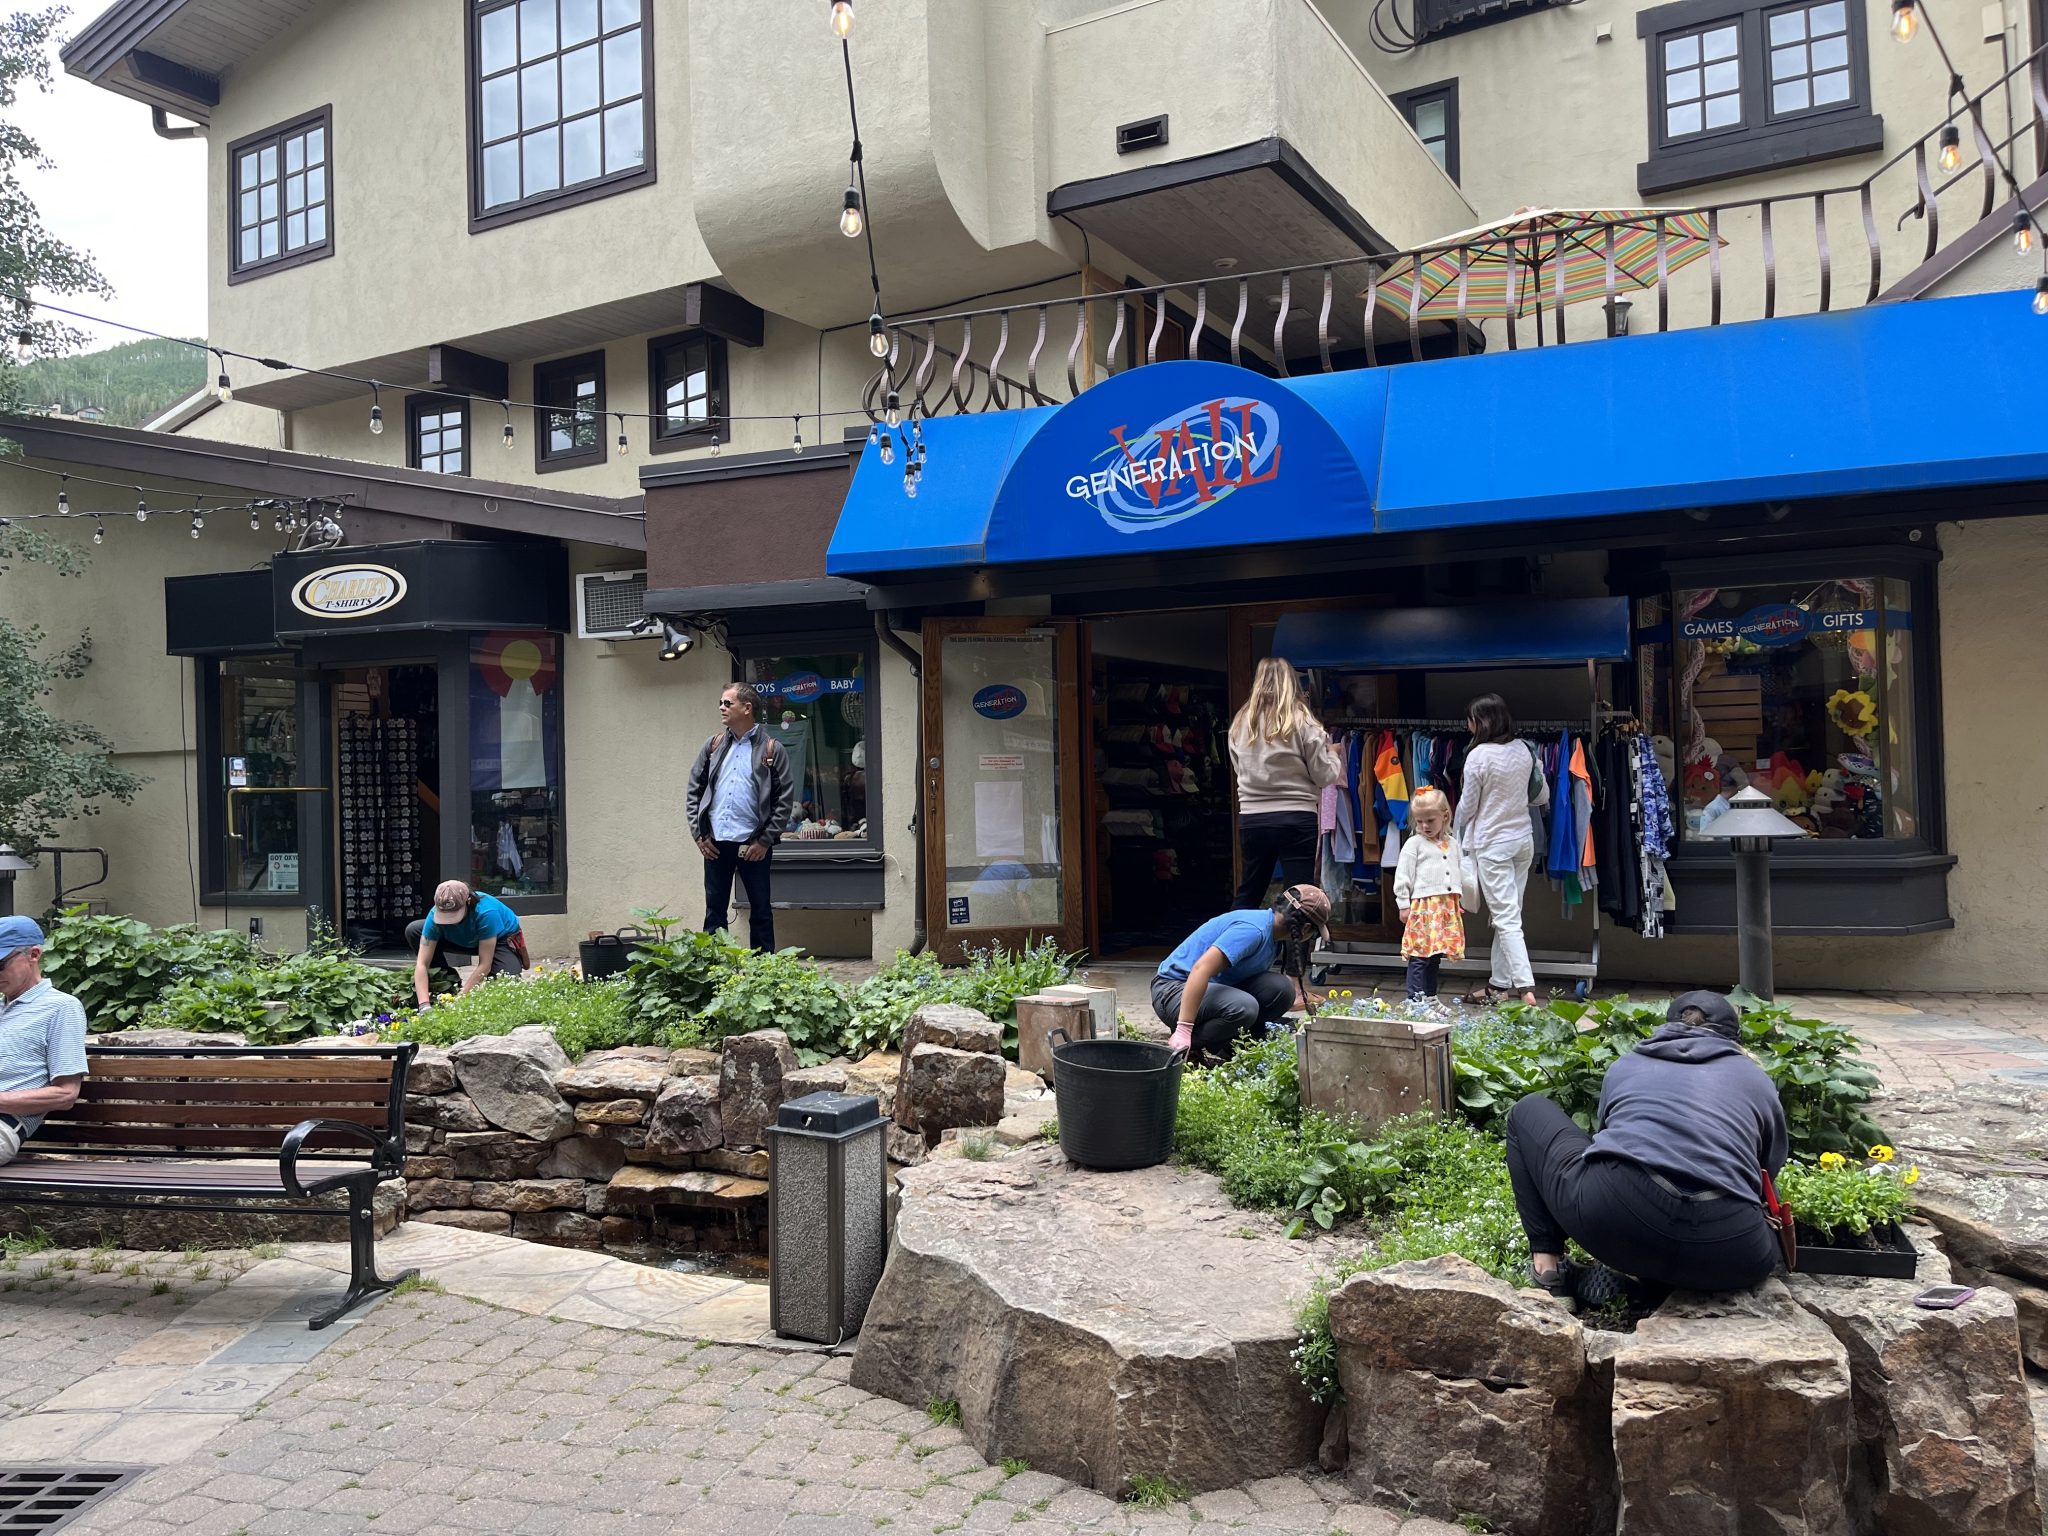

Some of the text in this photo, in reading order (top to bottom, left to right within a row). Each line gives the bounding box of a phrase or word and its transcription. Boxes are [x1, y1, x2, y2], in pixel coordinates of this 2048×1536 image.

[1109, 398, 1282, 508] VAIL
[1065, 432, 1259, 500] GENERATION
[325, 598, 373, 608] T-SHIRTS
[1684, 621, 1734, 635] GAMES
[1739, 618, 1799, 634] GENERATION
[1822, 613, 1864, 628] GIFTS
[781, 681, 817, 693] GENERATION
[830, 679, 855, 690] BABY
[974, 695, 1017, 709] GENERATION
